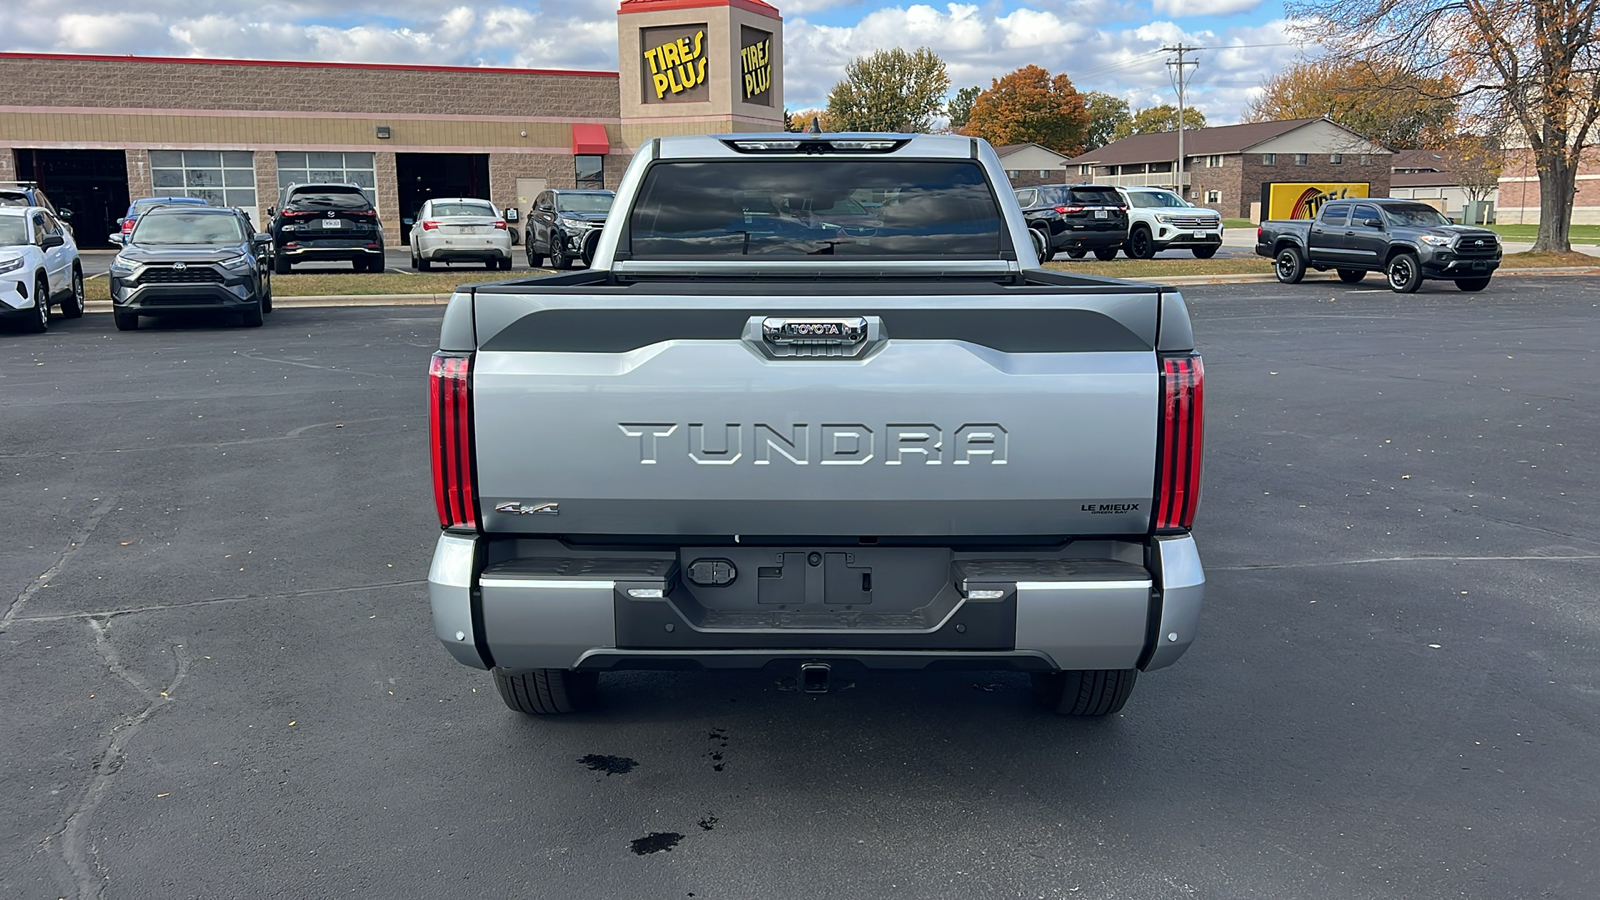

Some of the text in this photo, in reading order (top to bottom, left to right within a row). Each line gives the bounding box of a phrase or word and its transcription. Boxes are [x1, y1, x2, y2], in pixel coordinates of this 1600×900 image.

[644, 30, 704, 74] TIRES
[741, 39, 770, 73] TIRES
[652, 57, 707, 99] PLUS
[745, 64, 771, 99] PLUS
[792, 324, 839, 335] TOYOTA
[617, 422, 1009, 465] TUNDRA
